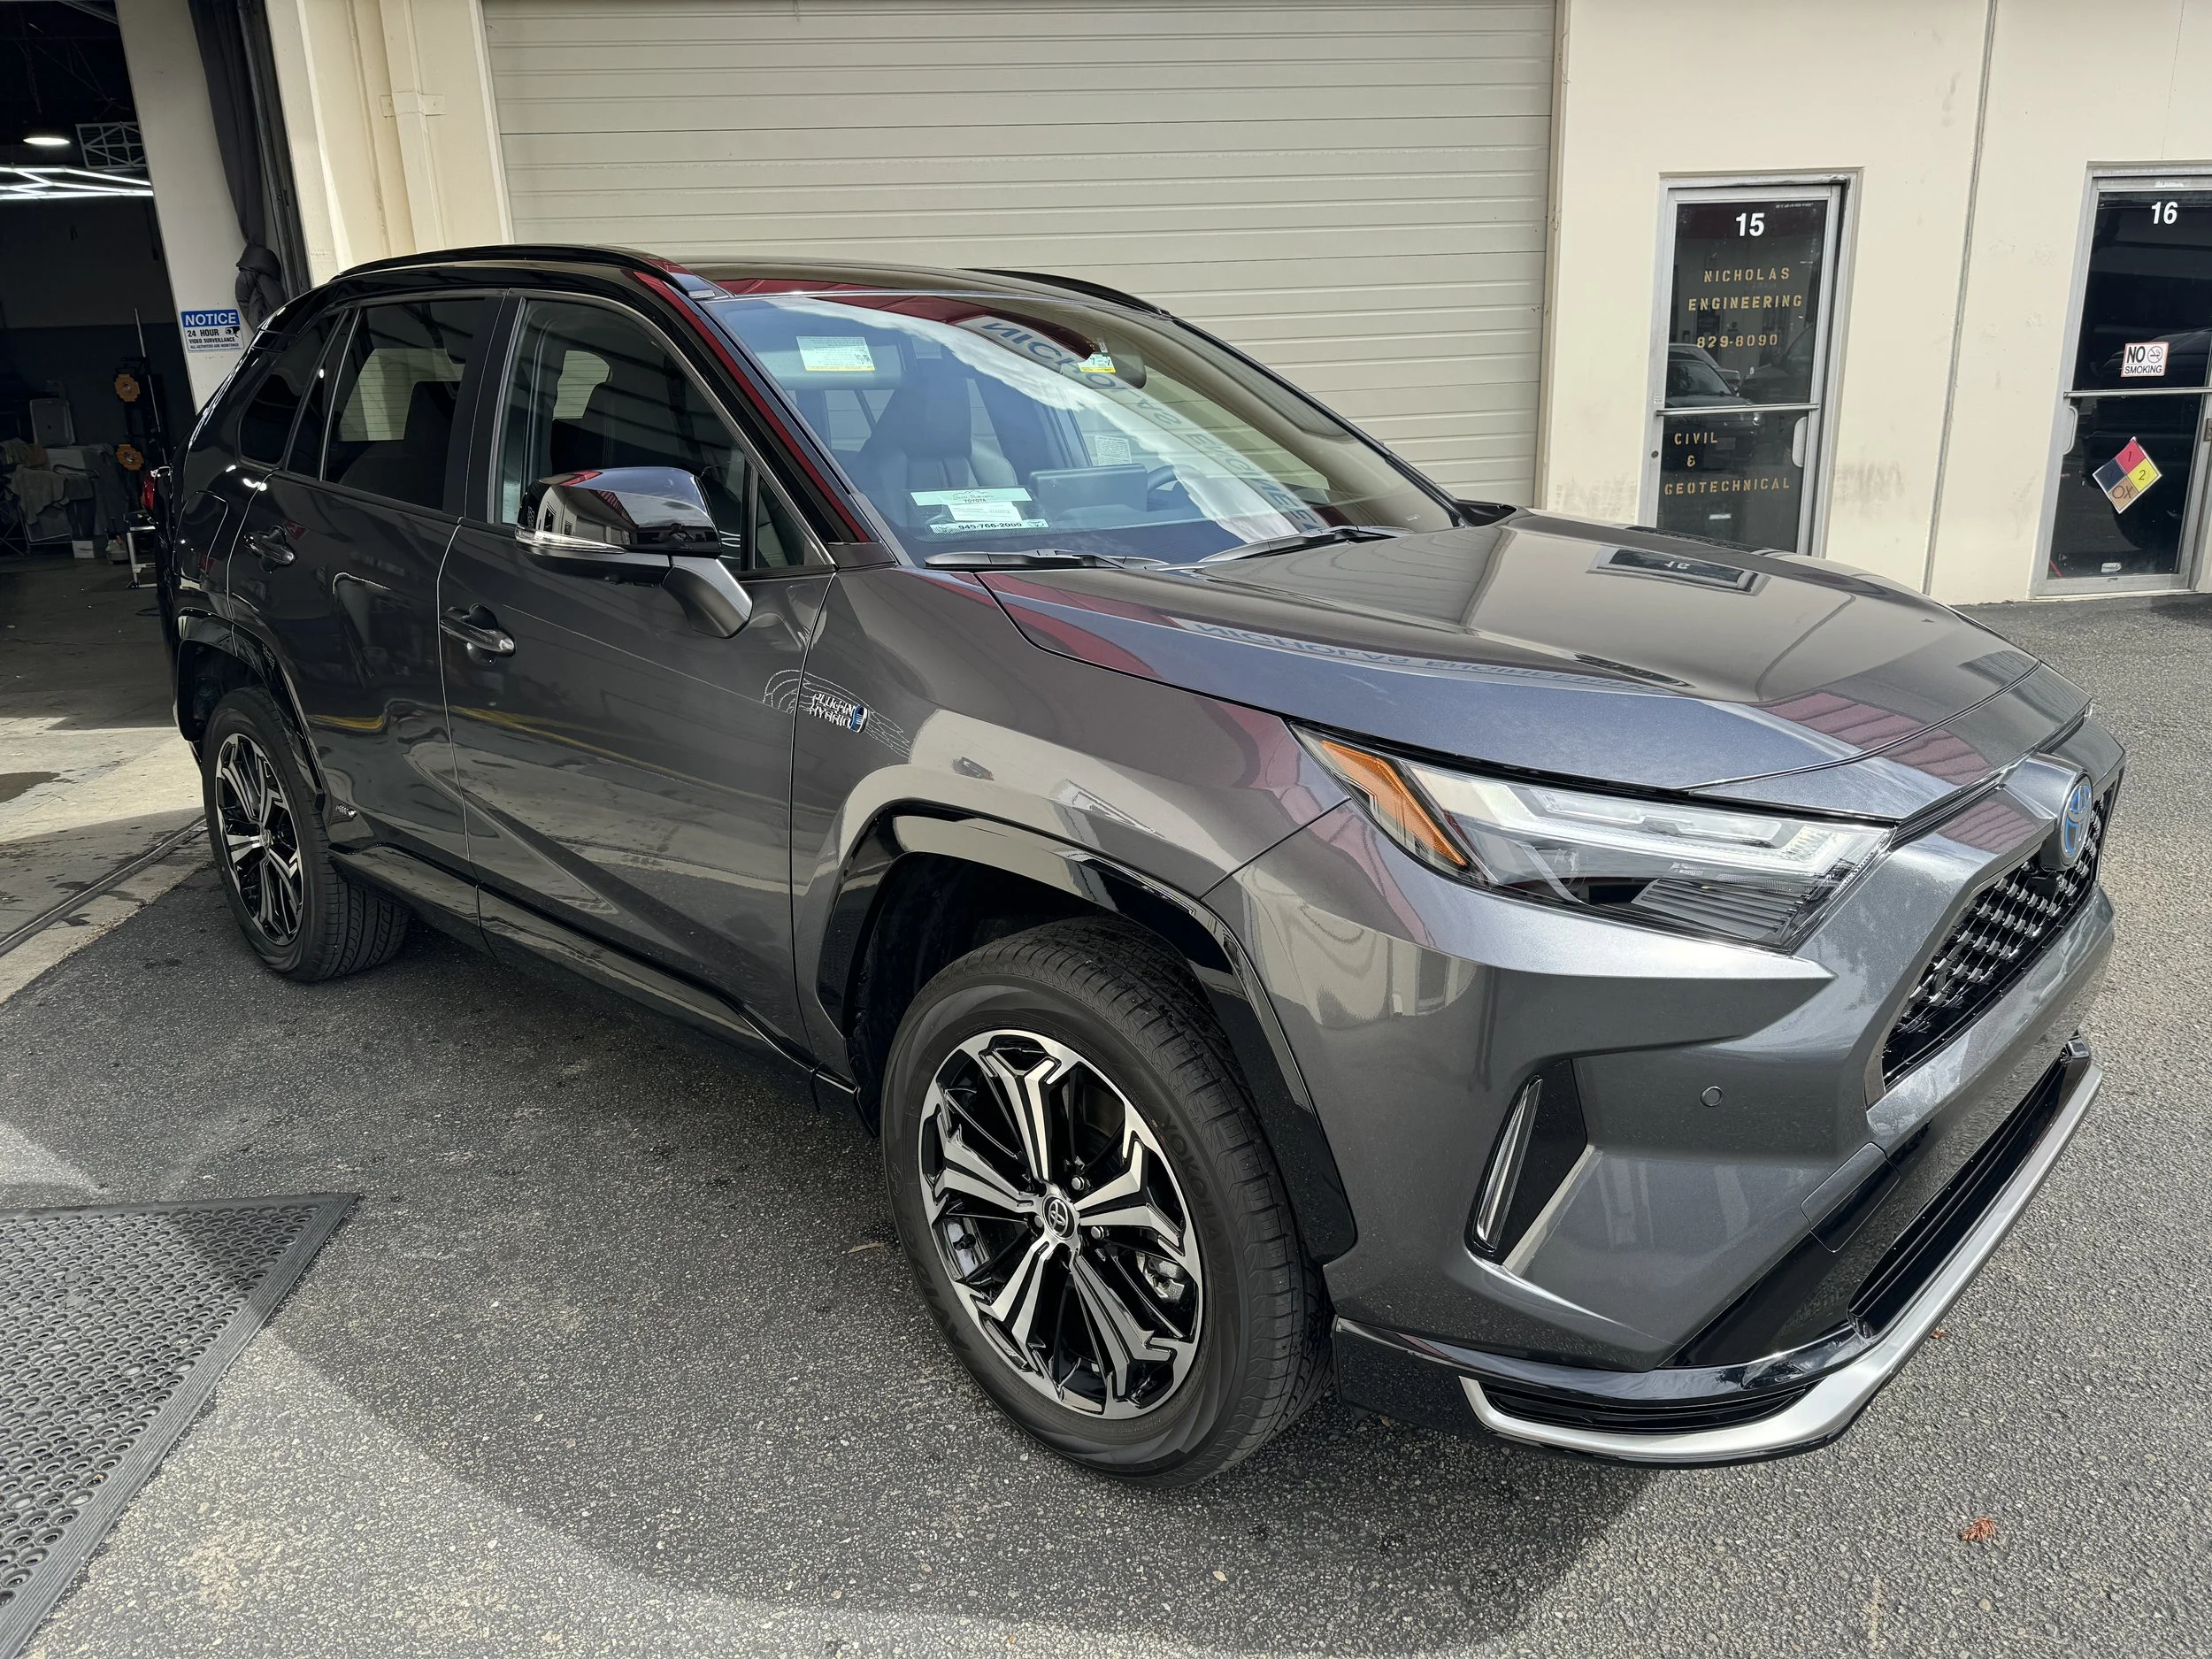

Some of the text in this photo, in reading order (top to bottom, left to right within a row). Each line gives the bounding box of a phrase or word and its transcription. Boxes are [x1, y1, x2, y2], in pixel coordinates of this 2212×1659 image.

[2151, 202, 2178, 224] 16
[1735, 212, 1765, 237] 15
[1703, 267, 1790, 283] NICHOLAS
[1688, 295, 1802, 311] ENGINEERING
[185, 312, 237, 326] NOTICE
[199, 328, 219, 337] HOUR
[1696, 334, 1778, 349] 829-8090
[2126, 345, 2146, 364] NO
[2124, 365, 2162, 374] SMOKING
[1674, 432, 1718, 445] CIVIL
[1686, 455, 1696, 467] &
[2128, 450, 2132, 462] 1
[2138, 469, 2147, 480] 2
[1664, 477, 1790, 495] GEOTECHNICAL
[2112, 485, 2133, 499] OX
